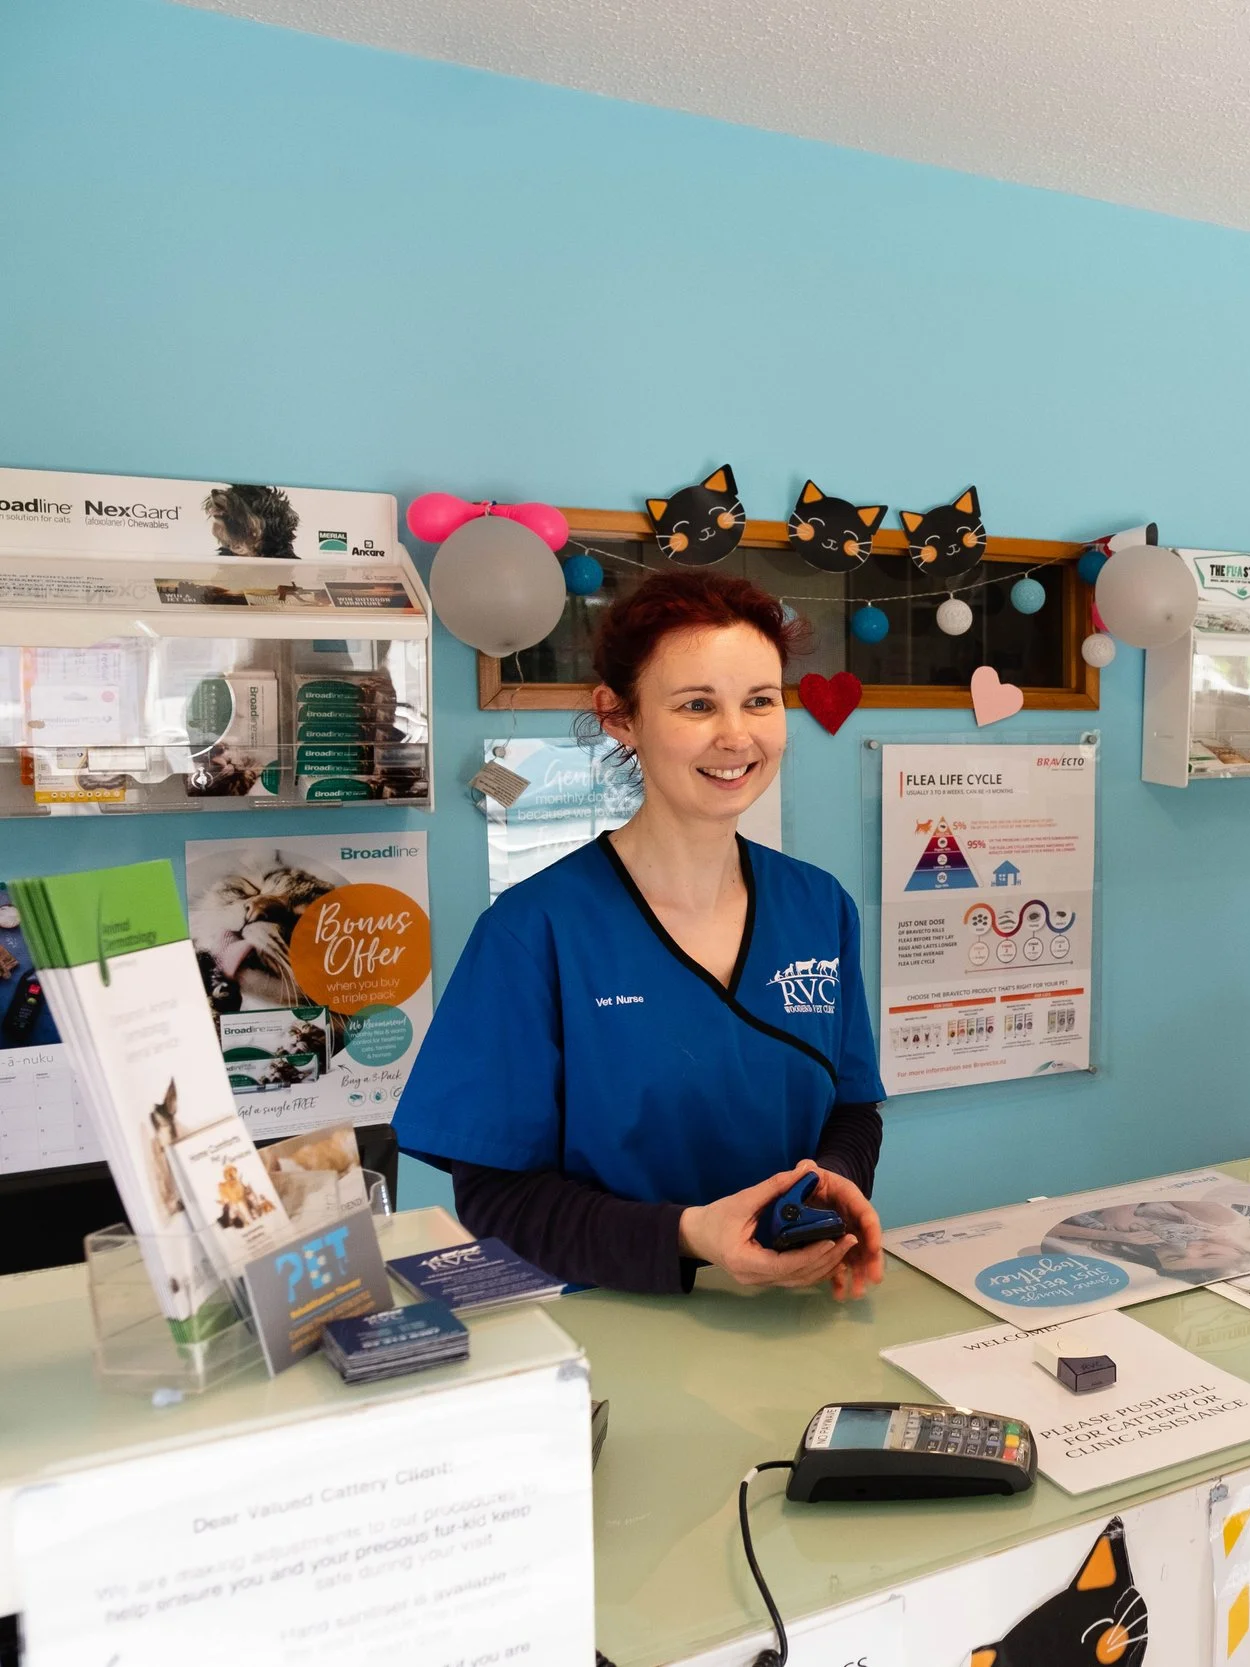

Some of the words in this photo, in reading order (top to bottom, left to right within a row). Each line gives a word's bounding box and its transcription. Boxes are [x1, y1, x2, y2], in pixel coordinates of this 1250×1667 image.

[6, 514, 39, 522] solution
[54, 516, 71, 524] cats
[85, 500, 180, 521] NexGard
[128, 519, 169, 529] Chewables
[352, 547, 385, 556] Ancare
[1210, 564, 1226, 577] THE
[249, 686, 260, 738] Broadline
[1037, 756, 1085, 768] BRAVECTO
[906, 774, 936, 786] FLEA
[939, 774, 963, 786] LIFE
[967, 773, 1003, 785] CYCLE
[536, 792, 587, 806] monthly
[518, 809, 571, 820] because
[574, 808, 591, 818] we
[952, 821, 967, 831] 5%
[340, 845, 418, 860] Broadline
[967, 840, 986, 849] 95%
[315, 902, 413, 944] Bonus
[324, 935, 406, 978] Offer
[327, 980, 357, 992] when
[358, 981, 379, 991] you
[380, 977, 400, 988] buy
[778, 978, 836, 1006] RVC
[907, 993, 930, 1001] CHOOSE
[942, 990, 971, 998] BRAVECTO
[972, 986, 997, 995] PRODUCT
[998, 985, 1016, 993] THAT'S
[1016, 983, 1032, 991] RIGHT
[341, 992, 368, 1003] triple
[369, 990, 396, 1002] pack
[595, 997, 613, 1007] Vet
[616, 995, 644, 1005] Nurse
[926, 1064, 961, 1075] information
[341, 1075, 361, 1090] Buy
[262, 1104, 291, 1118] single
[292, 1097, 319, 1111] FREE
[987, 1256, 1092, 1288] together
[1070, 1265, 1110, 1283] JUST
[1001, 1277, 1069, 1299] BELONG
[1019, 1286, 1075, 1303] things
[963, 1325, 1062, 1351] WELCOME!
[1040, 1413, 1115, 1440] PLEASE
[1115, 1397, 1167, 1417] PUSH
[1168, 1384, 1216, 1401] BELL
[1063, 1429, 1105, 1446] FOR
[1107, 1402, 1190, 1433] CATTERY
[1192, 1394, 1223, 1407] OR
[1065, 1433, 1135, 1459] CLINIC
[1138, 1399, 1249, 1439] ASSISTANCE
[193, 1510, 239, 1535] Dear
[247, 1493, 314, 1520] Valued
[320, 1475, 388, 1504] Cattery
[395, 1461, 454, 1486] Client:
[423, 1490, 518, 1526] procedures
[105, 1602, 151, 1627] help
[156, 1582, 224, 1613] ensure
[229, 1574, 264, 1598] you
[269, 1560, 306, 1582] and
[310, 1549, 349, 1576] your
[355, 1528, 429, 1563] precious
[434, 1513, 487, 1540] fur-kid
[491, 1503, 532, 1526] keep
[314, 1572, 353, 1593] safe
[358, 1552, 414, 1583] during
[461, 1532, 493, 1553] visit
[504, 1641, 532, 1659] are
